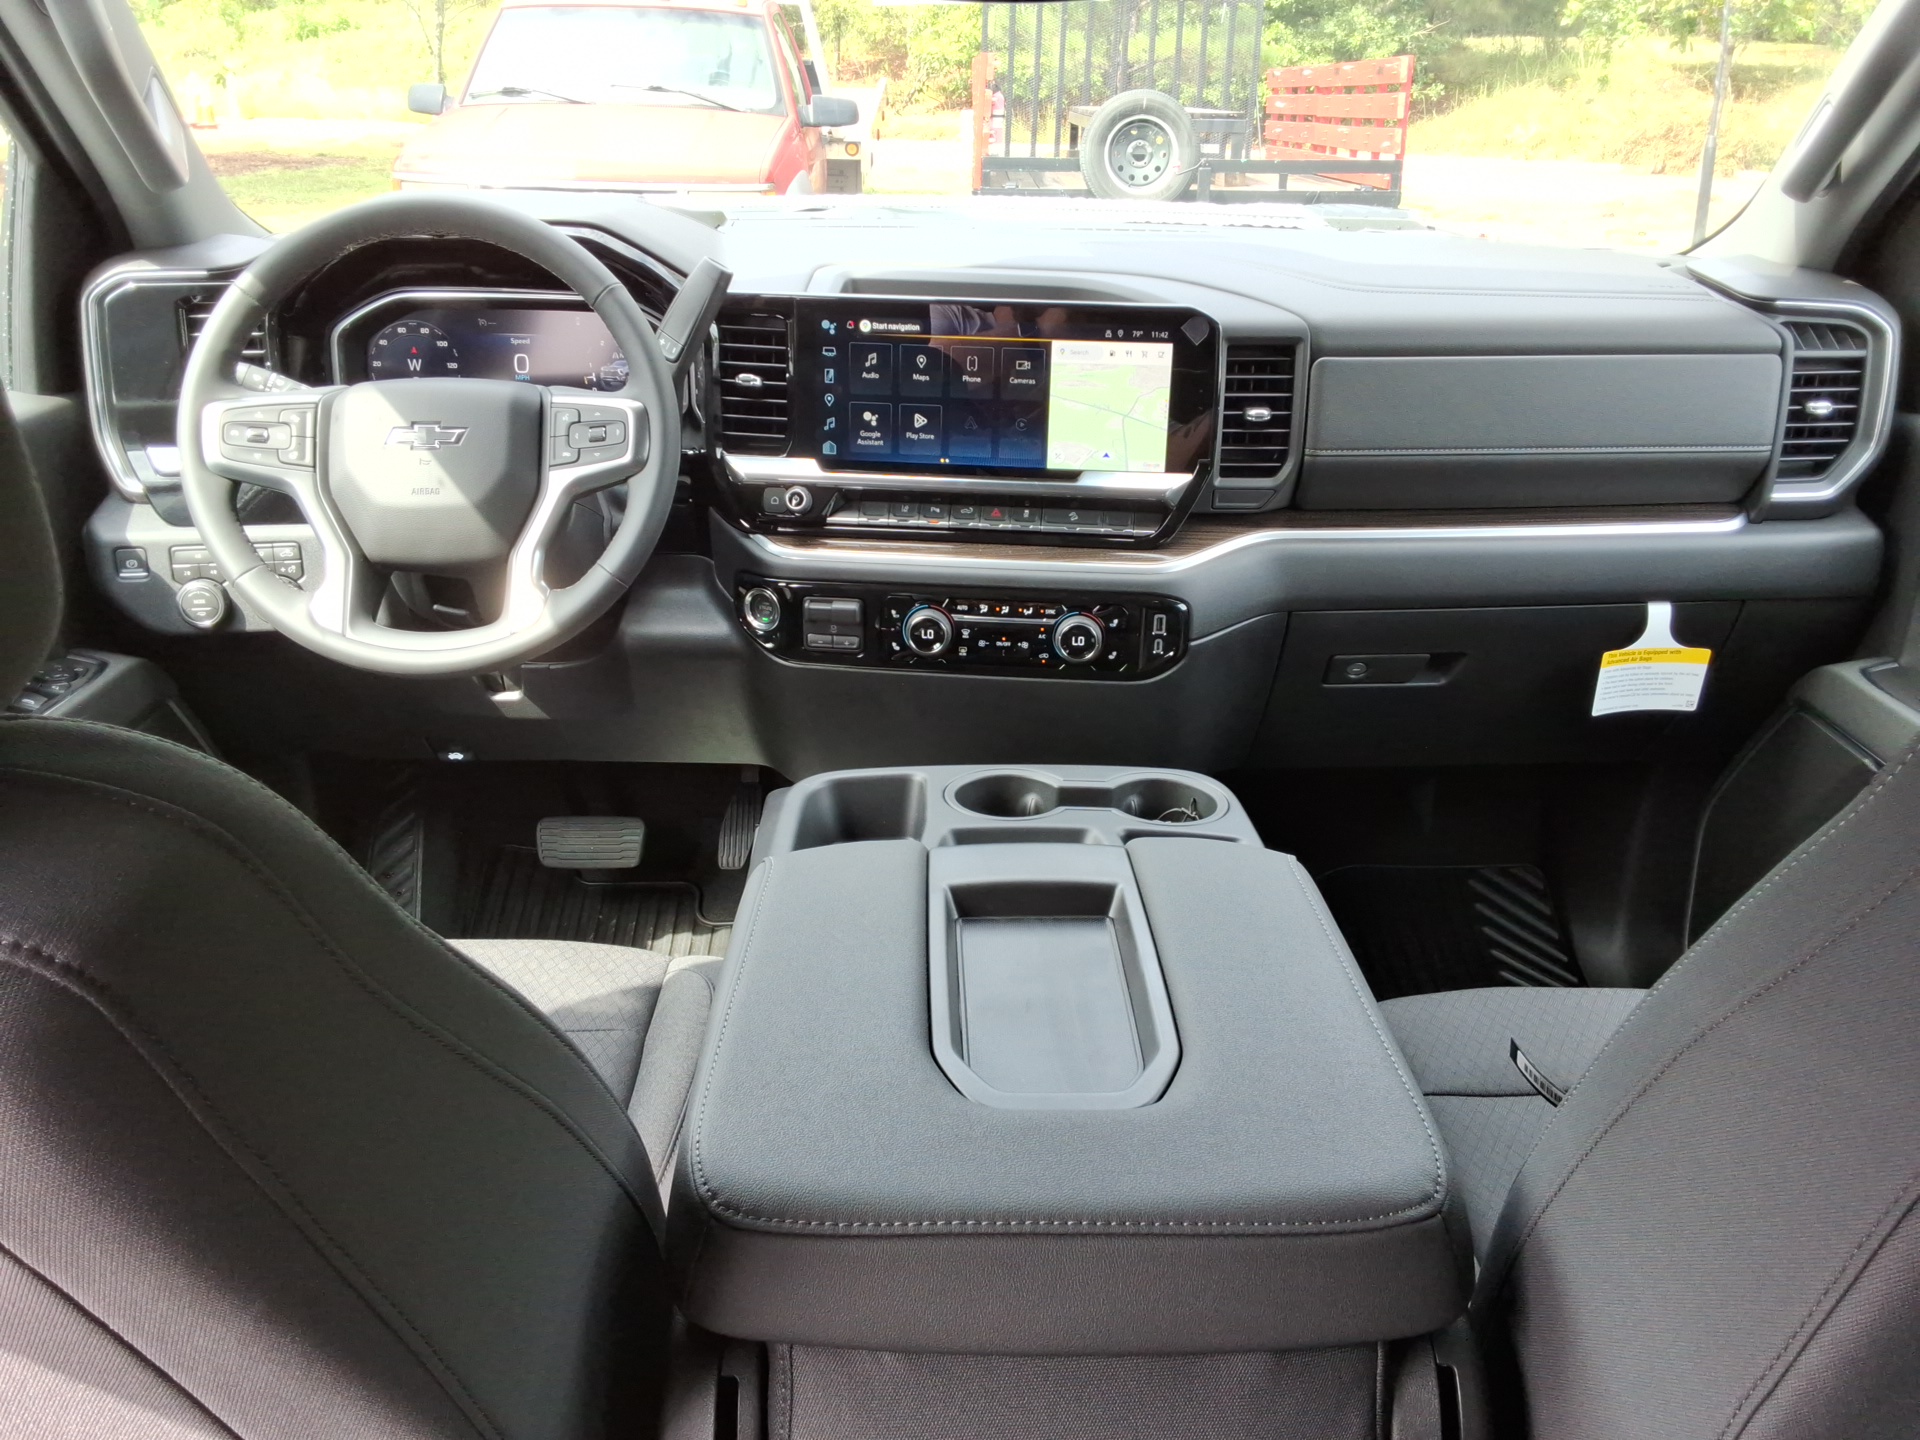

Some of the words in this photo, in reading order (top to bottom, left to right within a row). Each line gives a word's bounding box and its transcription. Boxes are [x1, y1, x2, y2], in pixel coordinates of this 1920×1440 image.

[872, 322, 887, 330] Start
[888, 322, 920, 332] navigation
[1151, 331, 1169, 339] 11:42
[407, 358, 422, 371] W
[912, 373, 930, 382] Maps
[962, 375, 981, 383] Phone
[1009, 376, 1036, 385] Cameras
[859, 430, 882, 438] Google
[906, 432, 918, 440] Play
[919, 432, 935, 440] Store
[857, 438, 884, 446] Assistant
[411, 487, 440, 496] AIRBAG
[921, 629, 935, 640] LO
[1071, 635, 1086, 647] LO
[1643, 648, 1669, 656] Equipped
[1606, 656, 1630, 665] Advanced
